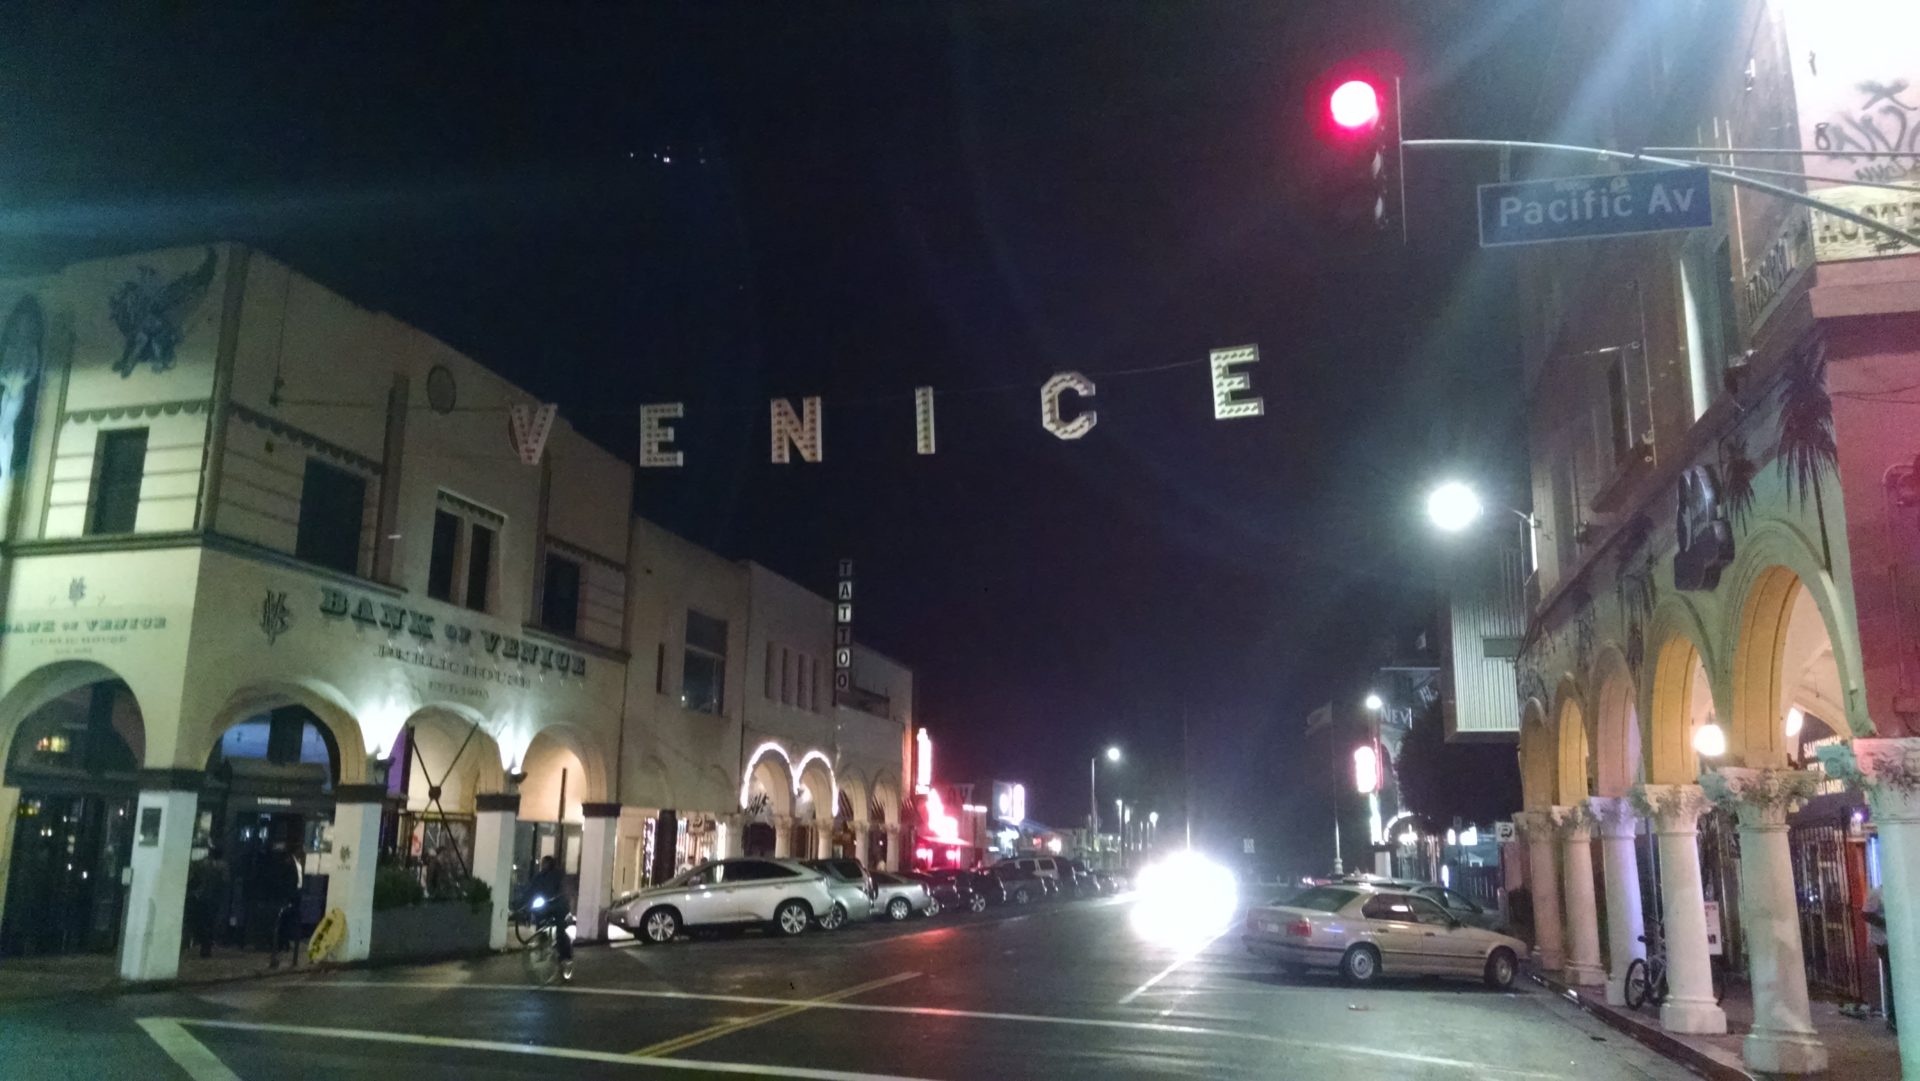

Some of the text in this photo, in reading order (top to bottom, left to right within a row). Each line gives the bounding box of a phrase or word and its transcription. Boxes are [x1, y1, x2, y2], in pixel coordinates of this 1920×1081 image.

[1499, 182, 1695, 228] Pacific Av
[510, 343, 1264, 467] VENICE
[319, 585, 436, 640] BANK
[480, 628, 586, 677] VENICE
[836, 560, 852, 690] TATTOO
